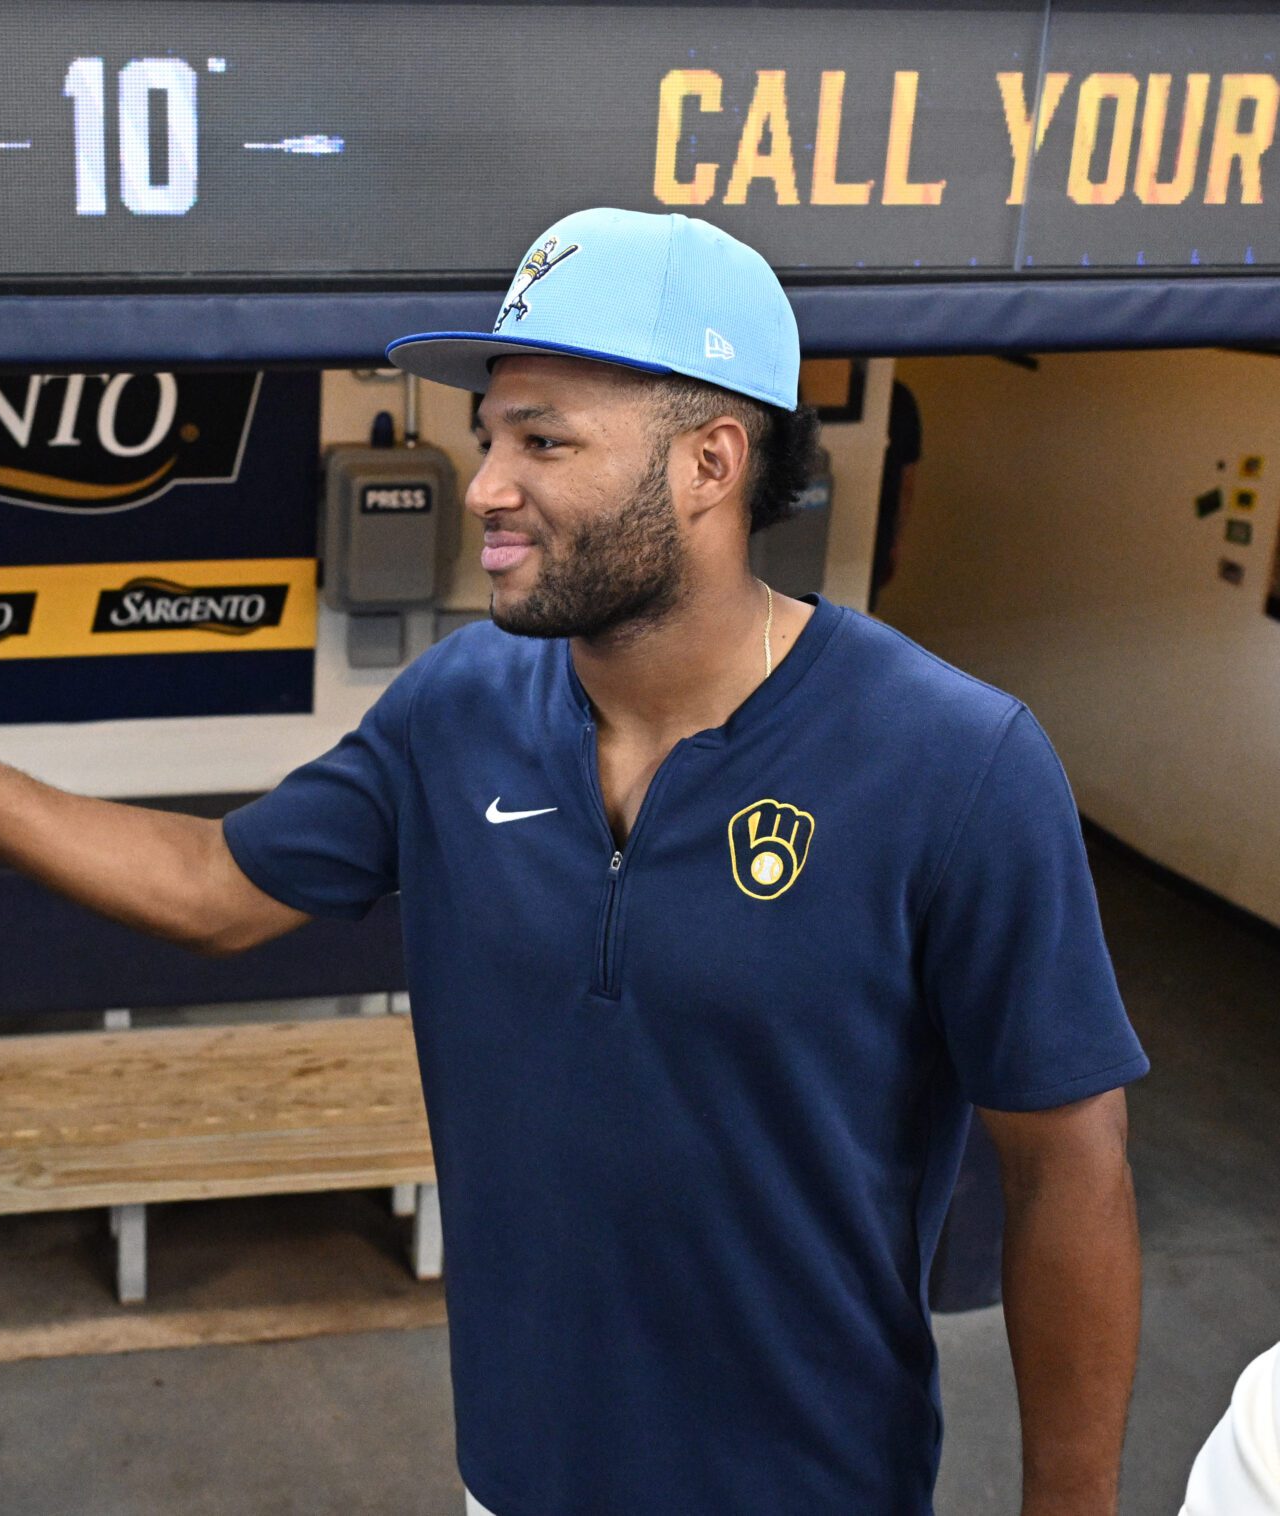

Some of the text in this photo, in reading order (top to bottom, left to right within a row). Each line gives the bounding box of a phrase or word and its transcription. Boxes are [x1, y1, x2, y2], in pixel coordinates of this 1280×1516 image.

[654, 69, 1280, 205] CALL YOUR
[366, 489, 427, 510] PRESS
[109, 591, 267, 626] SARGENTO
